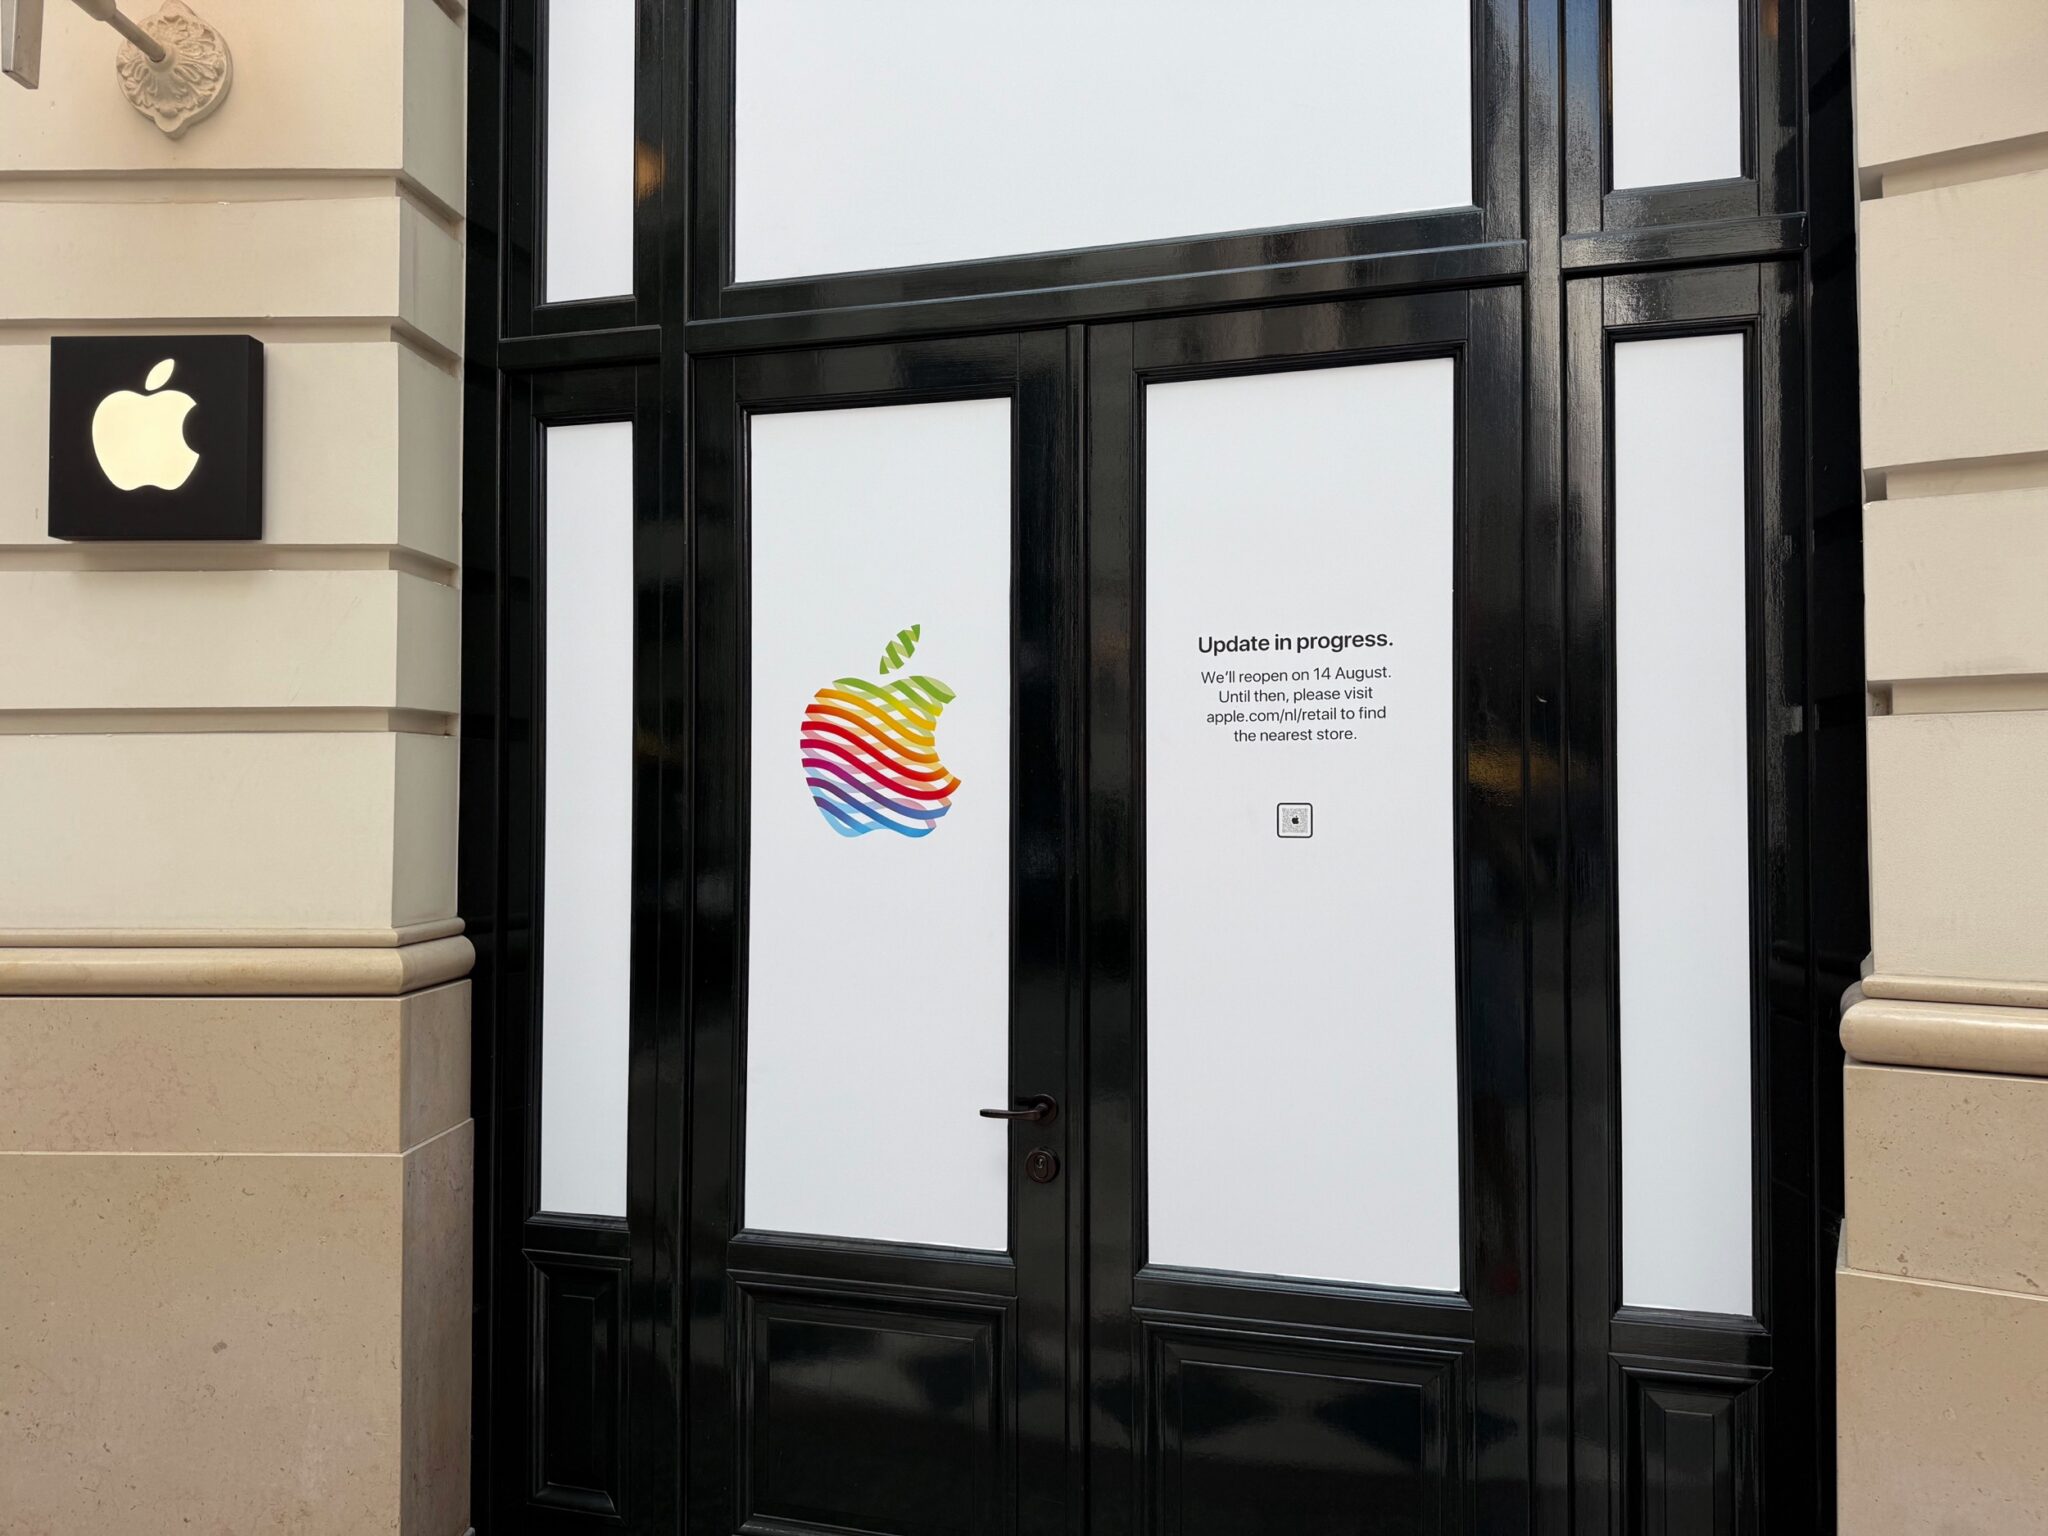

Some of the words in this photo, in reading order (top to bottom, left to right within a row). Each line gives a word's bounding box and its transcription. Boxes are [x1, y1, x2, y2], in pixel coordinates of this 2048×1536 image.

[1199, 635, 1270, 656] Update
[1275, 634, 1291, 650] in
[1297, 634, 1393, 653] progress.
[1239, 672, 1287, 684] reopen
[1292, 671, 1309, 681] on
[1314, 667, 1331, 680] 14
[1335, 666, 1391, 682] August.
[1219, 690, 1250, 703] Until
[1254, 689, 1289, 703] then,
[1294, 688, 1340, 703] please
[1344, 687, 1373, 699] visit
[1207, 707, 1336, 725] apple.com/nl/retail
[1340, 708, 1355, 719] to
[1359, 706, 1386, 719] find
[1234, 730, 1256, 742] the
[1260, 729, 1312, 741] nearest
[1317, 729, 1356, 740] store.
